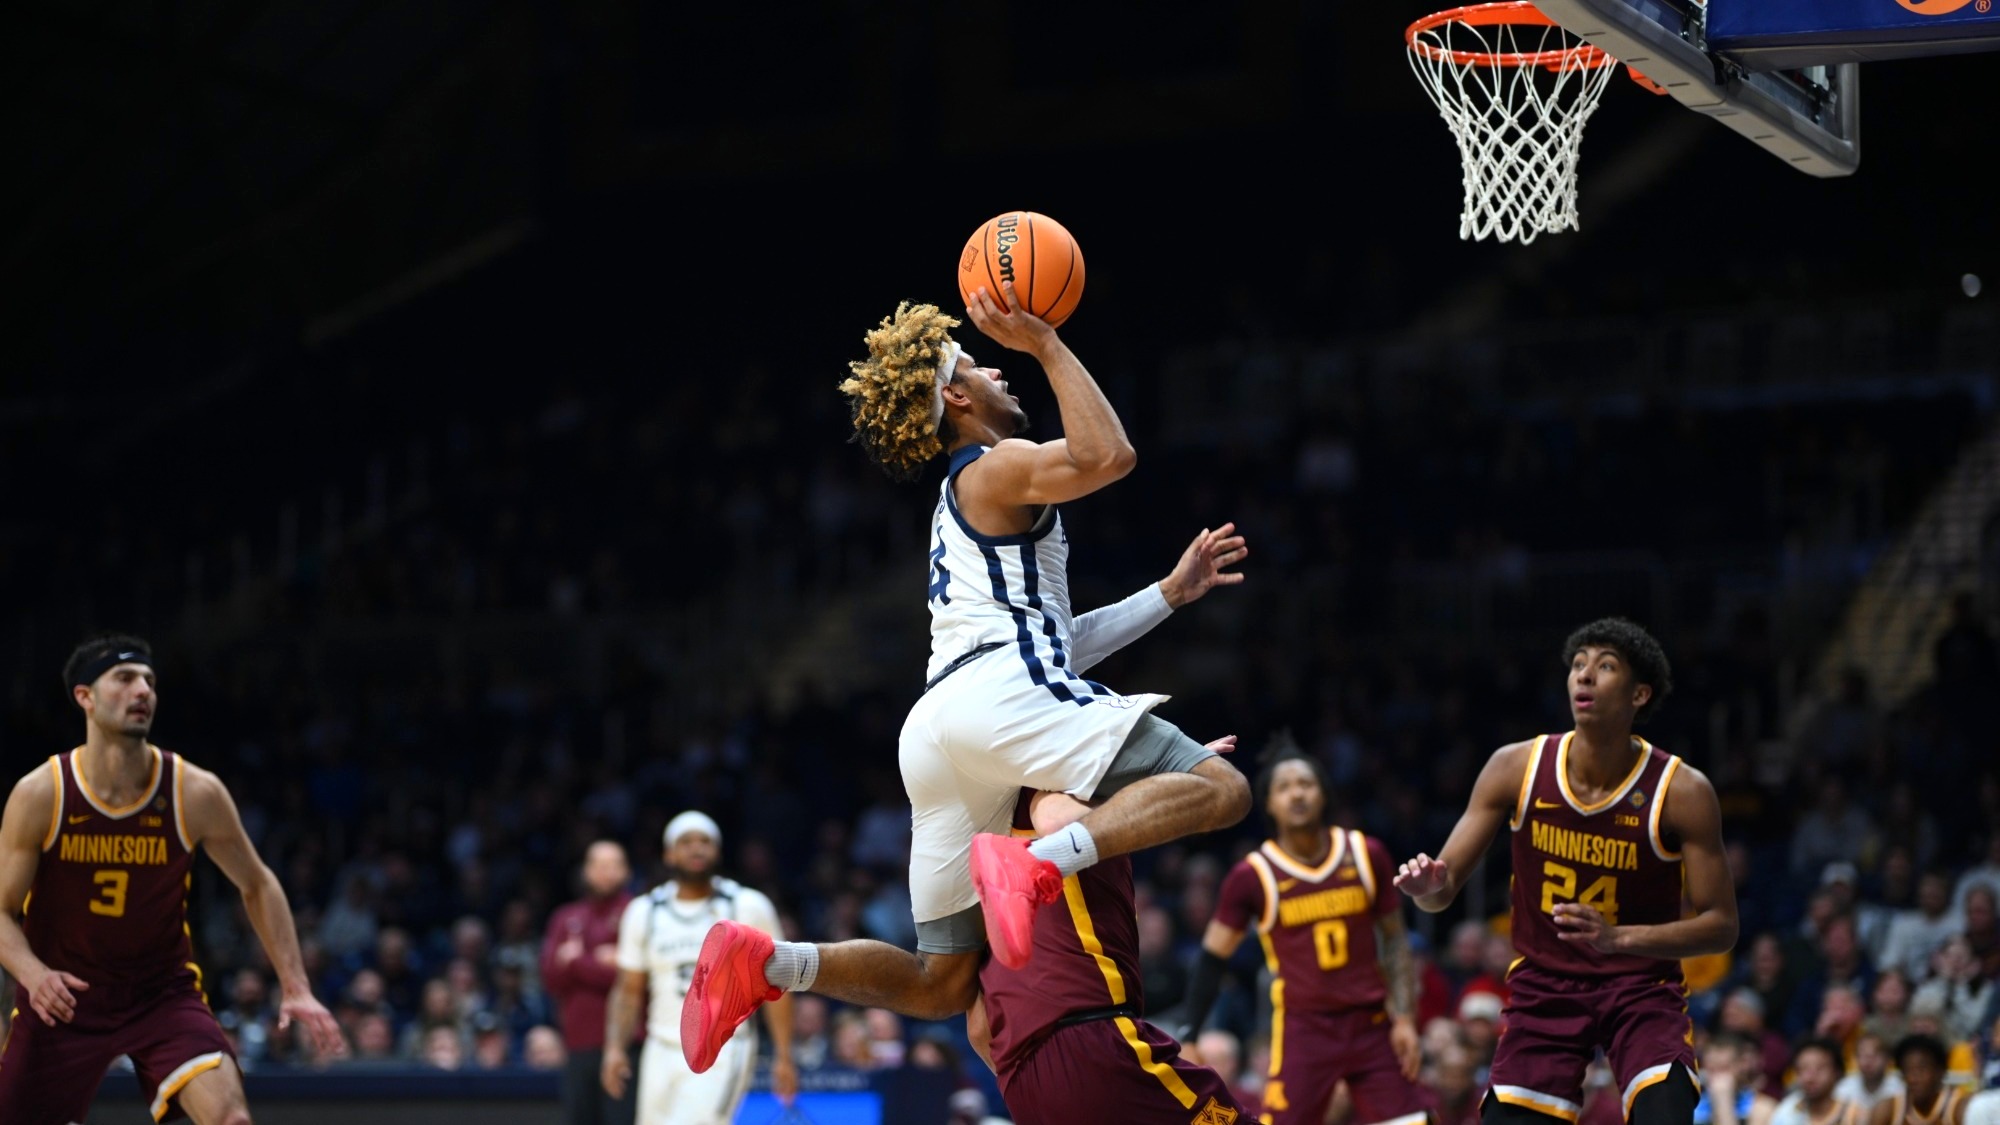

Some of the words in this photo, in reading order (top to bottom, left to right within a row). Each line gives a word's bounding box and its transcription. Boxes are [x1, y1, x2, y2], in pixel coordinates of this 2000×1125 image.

[997, 214, 1018, 284] Wilson
[60, 834, 168, 865] MINNESOTA
[1531, 819, 1638, 871] MINNESOTA
[89, 869, 129, 917] 3
[1541, 861, 1618, 926] 24
[1313, 919, 1348, 972] 0
